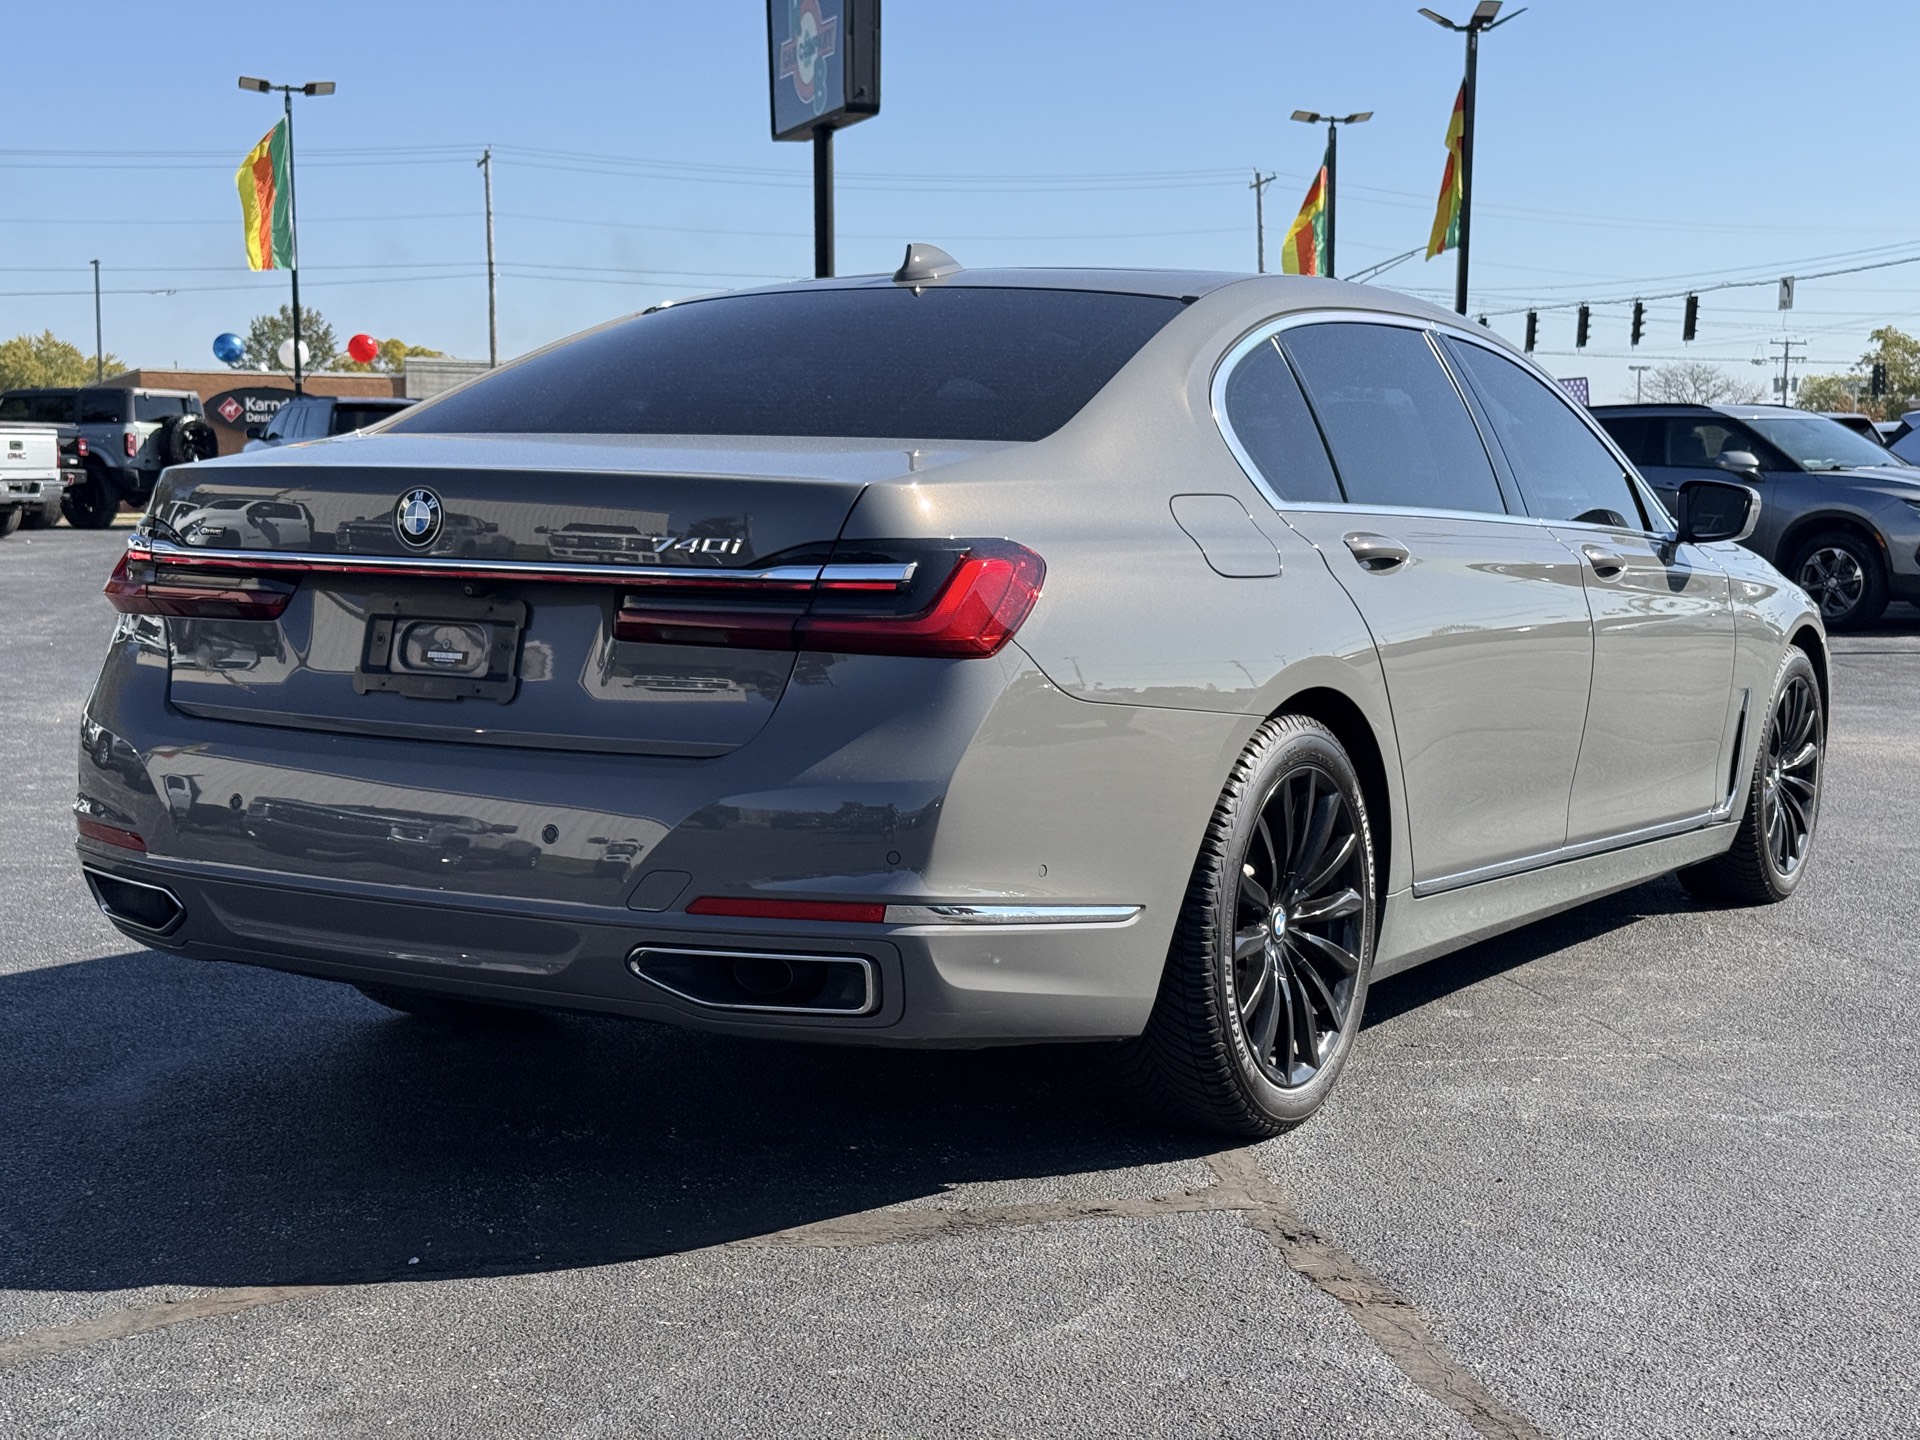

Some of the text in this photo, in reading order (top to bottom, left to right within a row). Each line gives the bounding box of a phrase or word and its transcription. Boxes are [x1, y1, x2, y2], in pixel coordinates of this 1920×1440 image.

[8, 452, 27, 460] GMC
[401, 491, 438, 509] BMW
[652, 537, 744, 554] 740i
[1225, 963, 1247, 1061] MICHELIN
